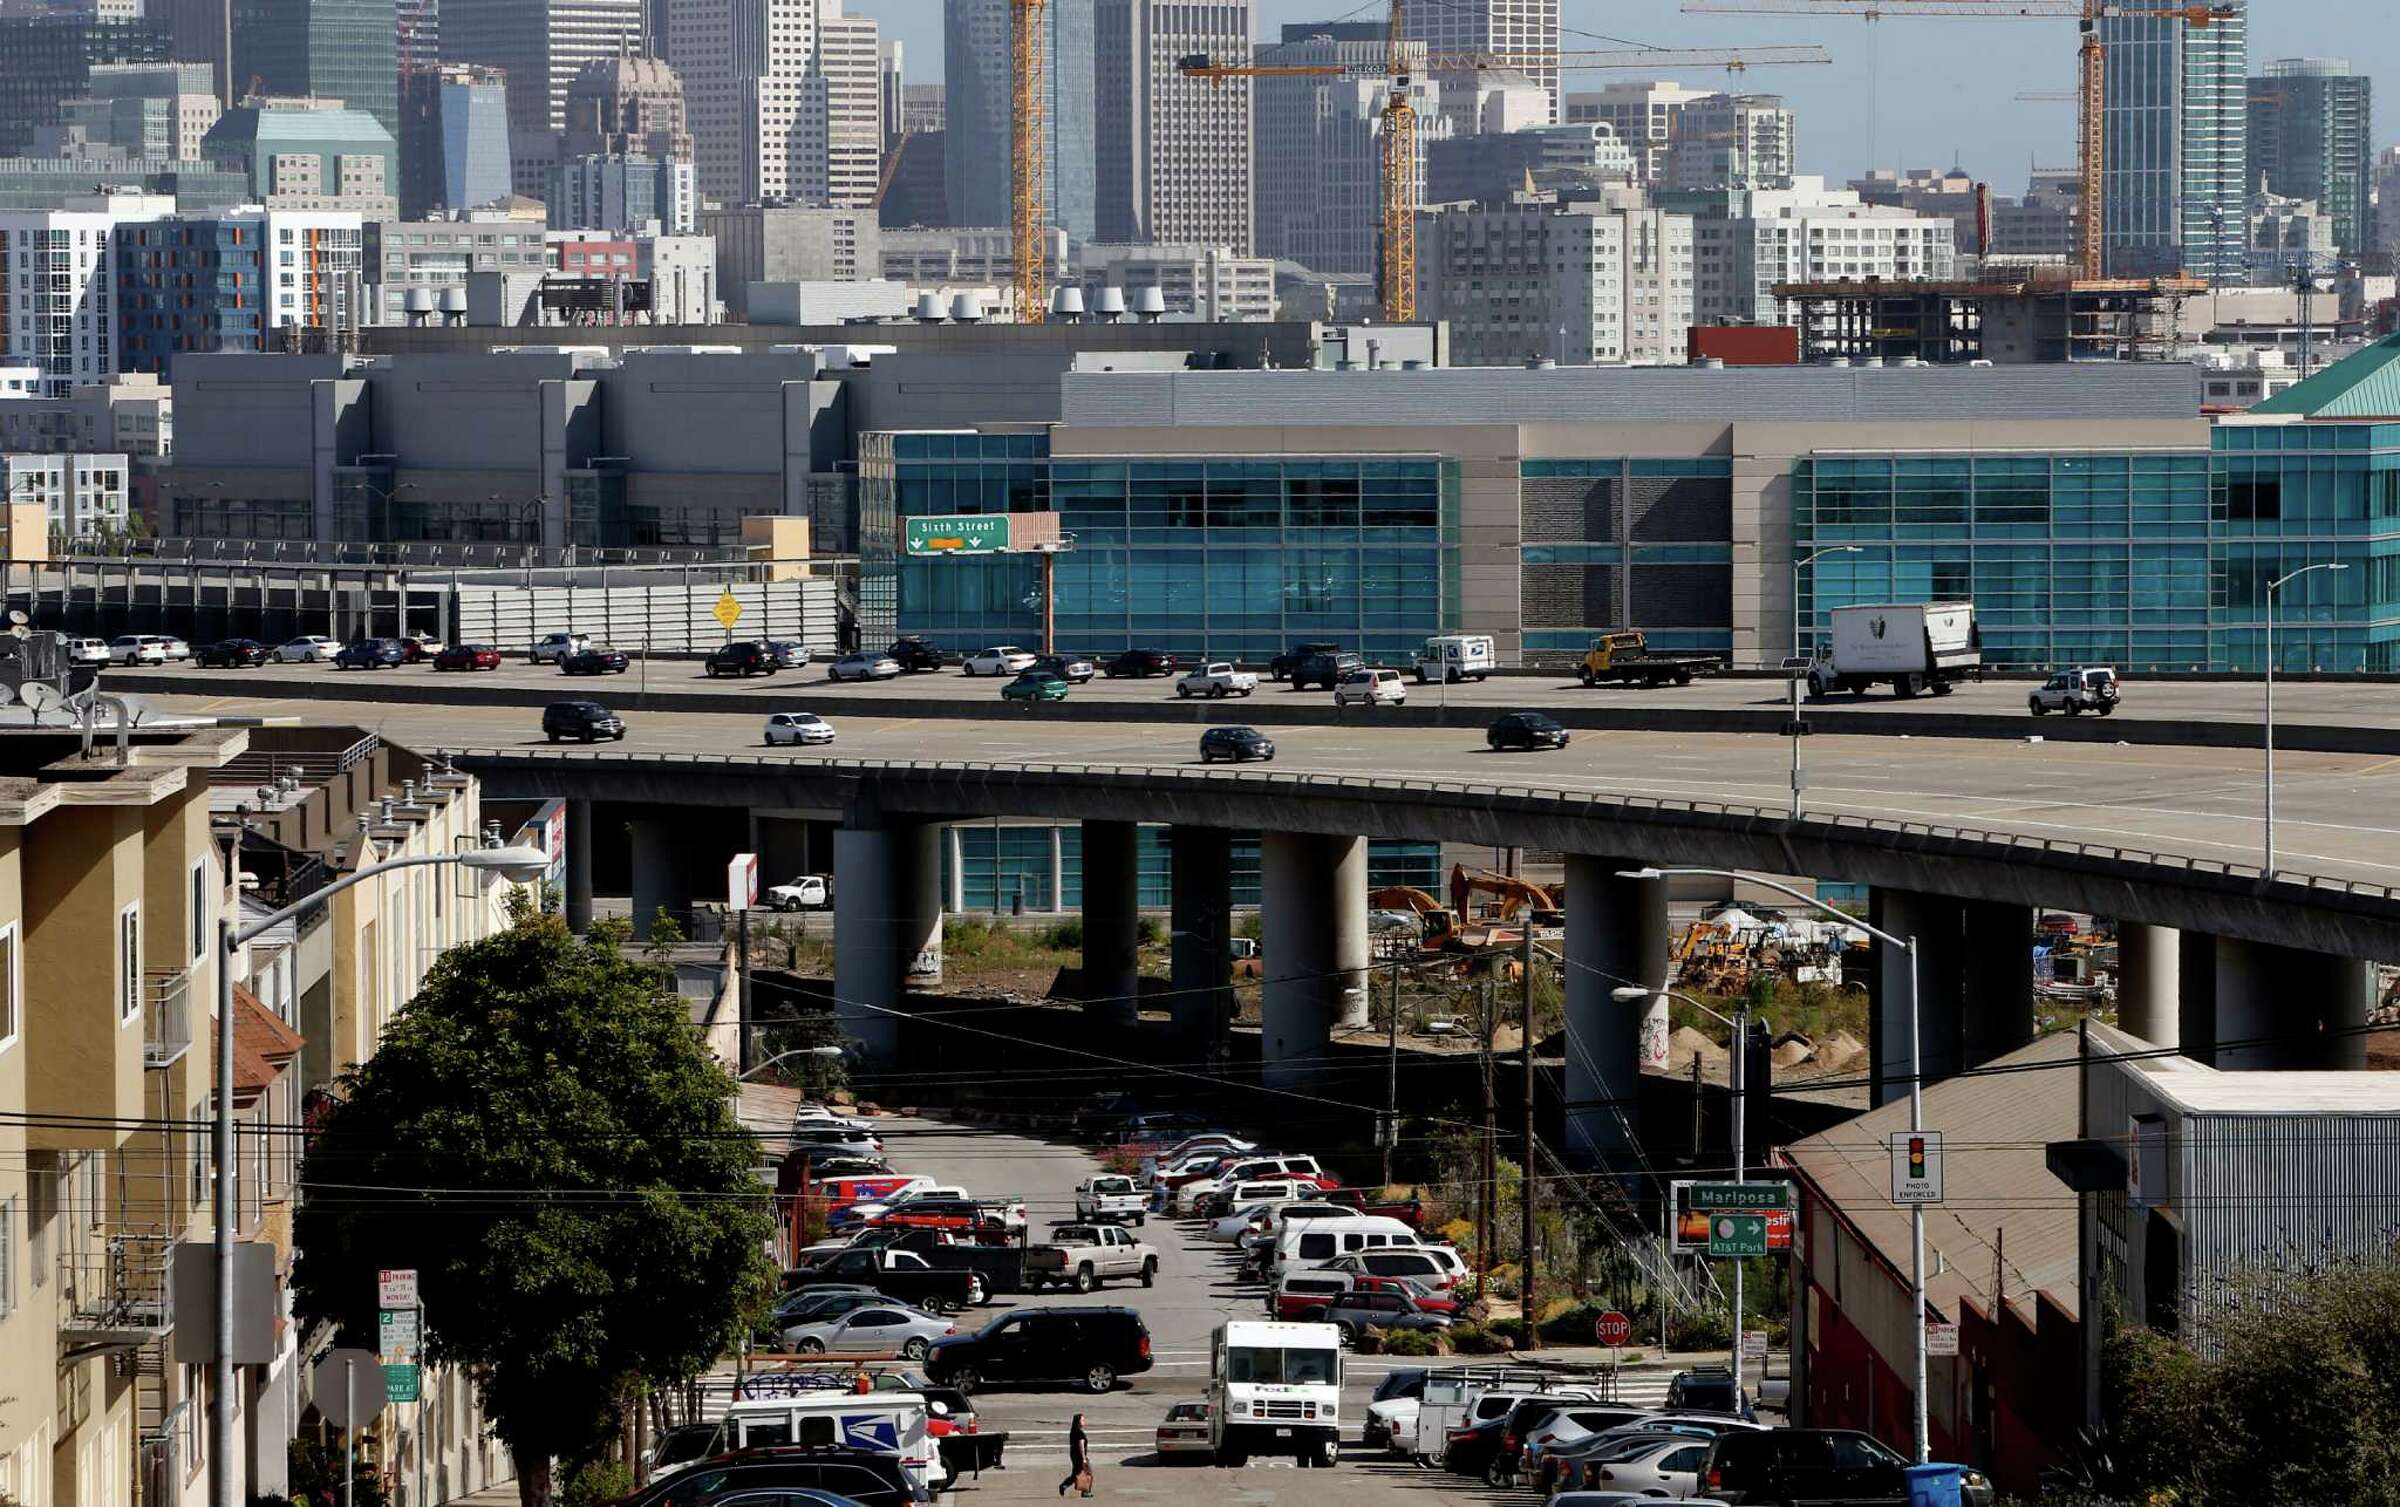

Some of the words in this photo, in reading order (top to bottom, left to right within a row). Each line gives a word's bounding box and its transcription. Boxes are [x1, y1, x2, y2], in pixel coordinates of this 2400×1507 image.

[921, 521, 952, 532] Sixth
[957, 521, 995, 531] Street
[1701, 1191, 1776, 1205] Mariposa
[1713, 1242, 1737, 1252] AT&T
[1740, 1241, 1764, 1252] Park
[383, 1313, 391, 1323] 2
[1598, 1322, 1628, 1336] STOP
